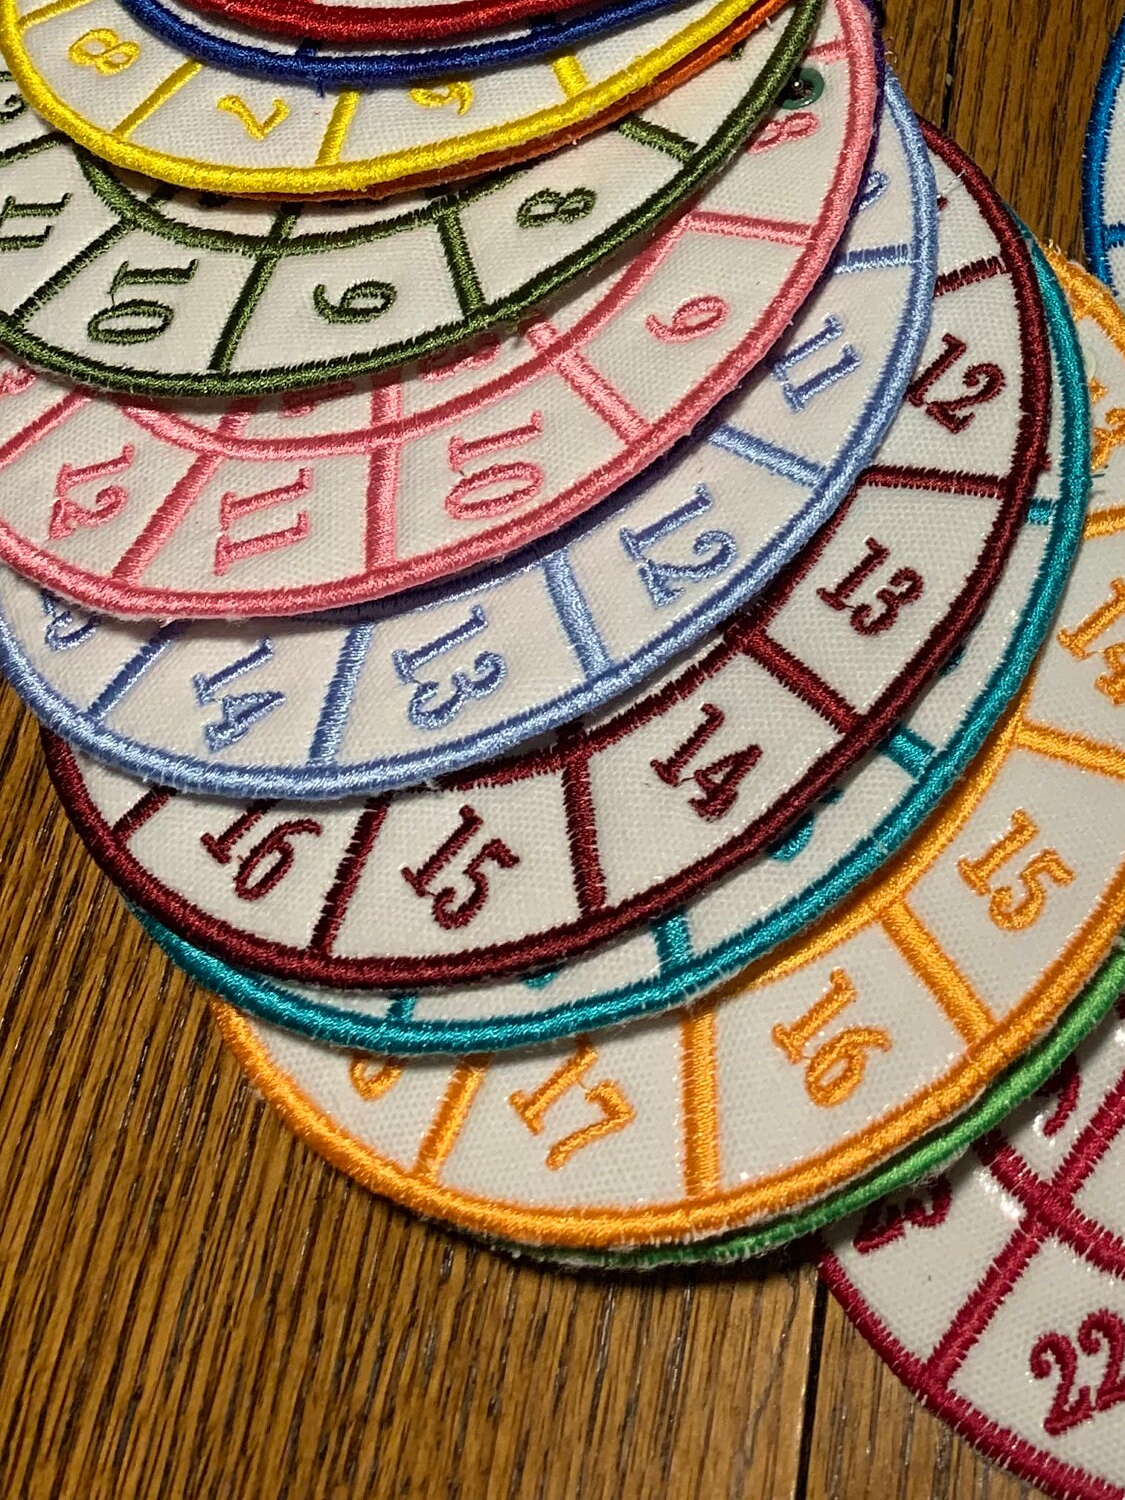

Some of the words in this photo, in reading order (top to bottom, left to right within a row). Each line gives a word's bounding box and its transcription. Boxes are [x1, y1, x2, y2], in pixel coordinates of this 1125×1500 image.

[69, 27, 140, 76] 8
[217, 94, 290, 140] 7
[516, 186, 598, 229] 8
[87, 259, 199, 347] 10
[769, 313, 862, 413] 11
[908, 333, 1007, 436] 12
[49, 443, 135, 540] 12
[445, 410, 544, 521] 10
[213, 467, 313, 577] 11
[619, 483, 739, 609] 12
[816, 537, 926, 637] 13
[193, 635, 286, 754] 14
[393, 605, 508, 731] 13
[650, 704, 763, 822] 14
[200, 798, 323, 903] 16
[400, 805, 521, 931] 15
[956, 808, 1077, 933] 15
[771, 967, 893, 1109] 16
[507, 1035, 637, 1172] 17
